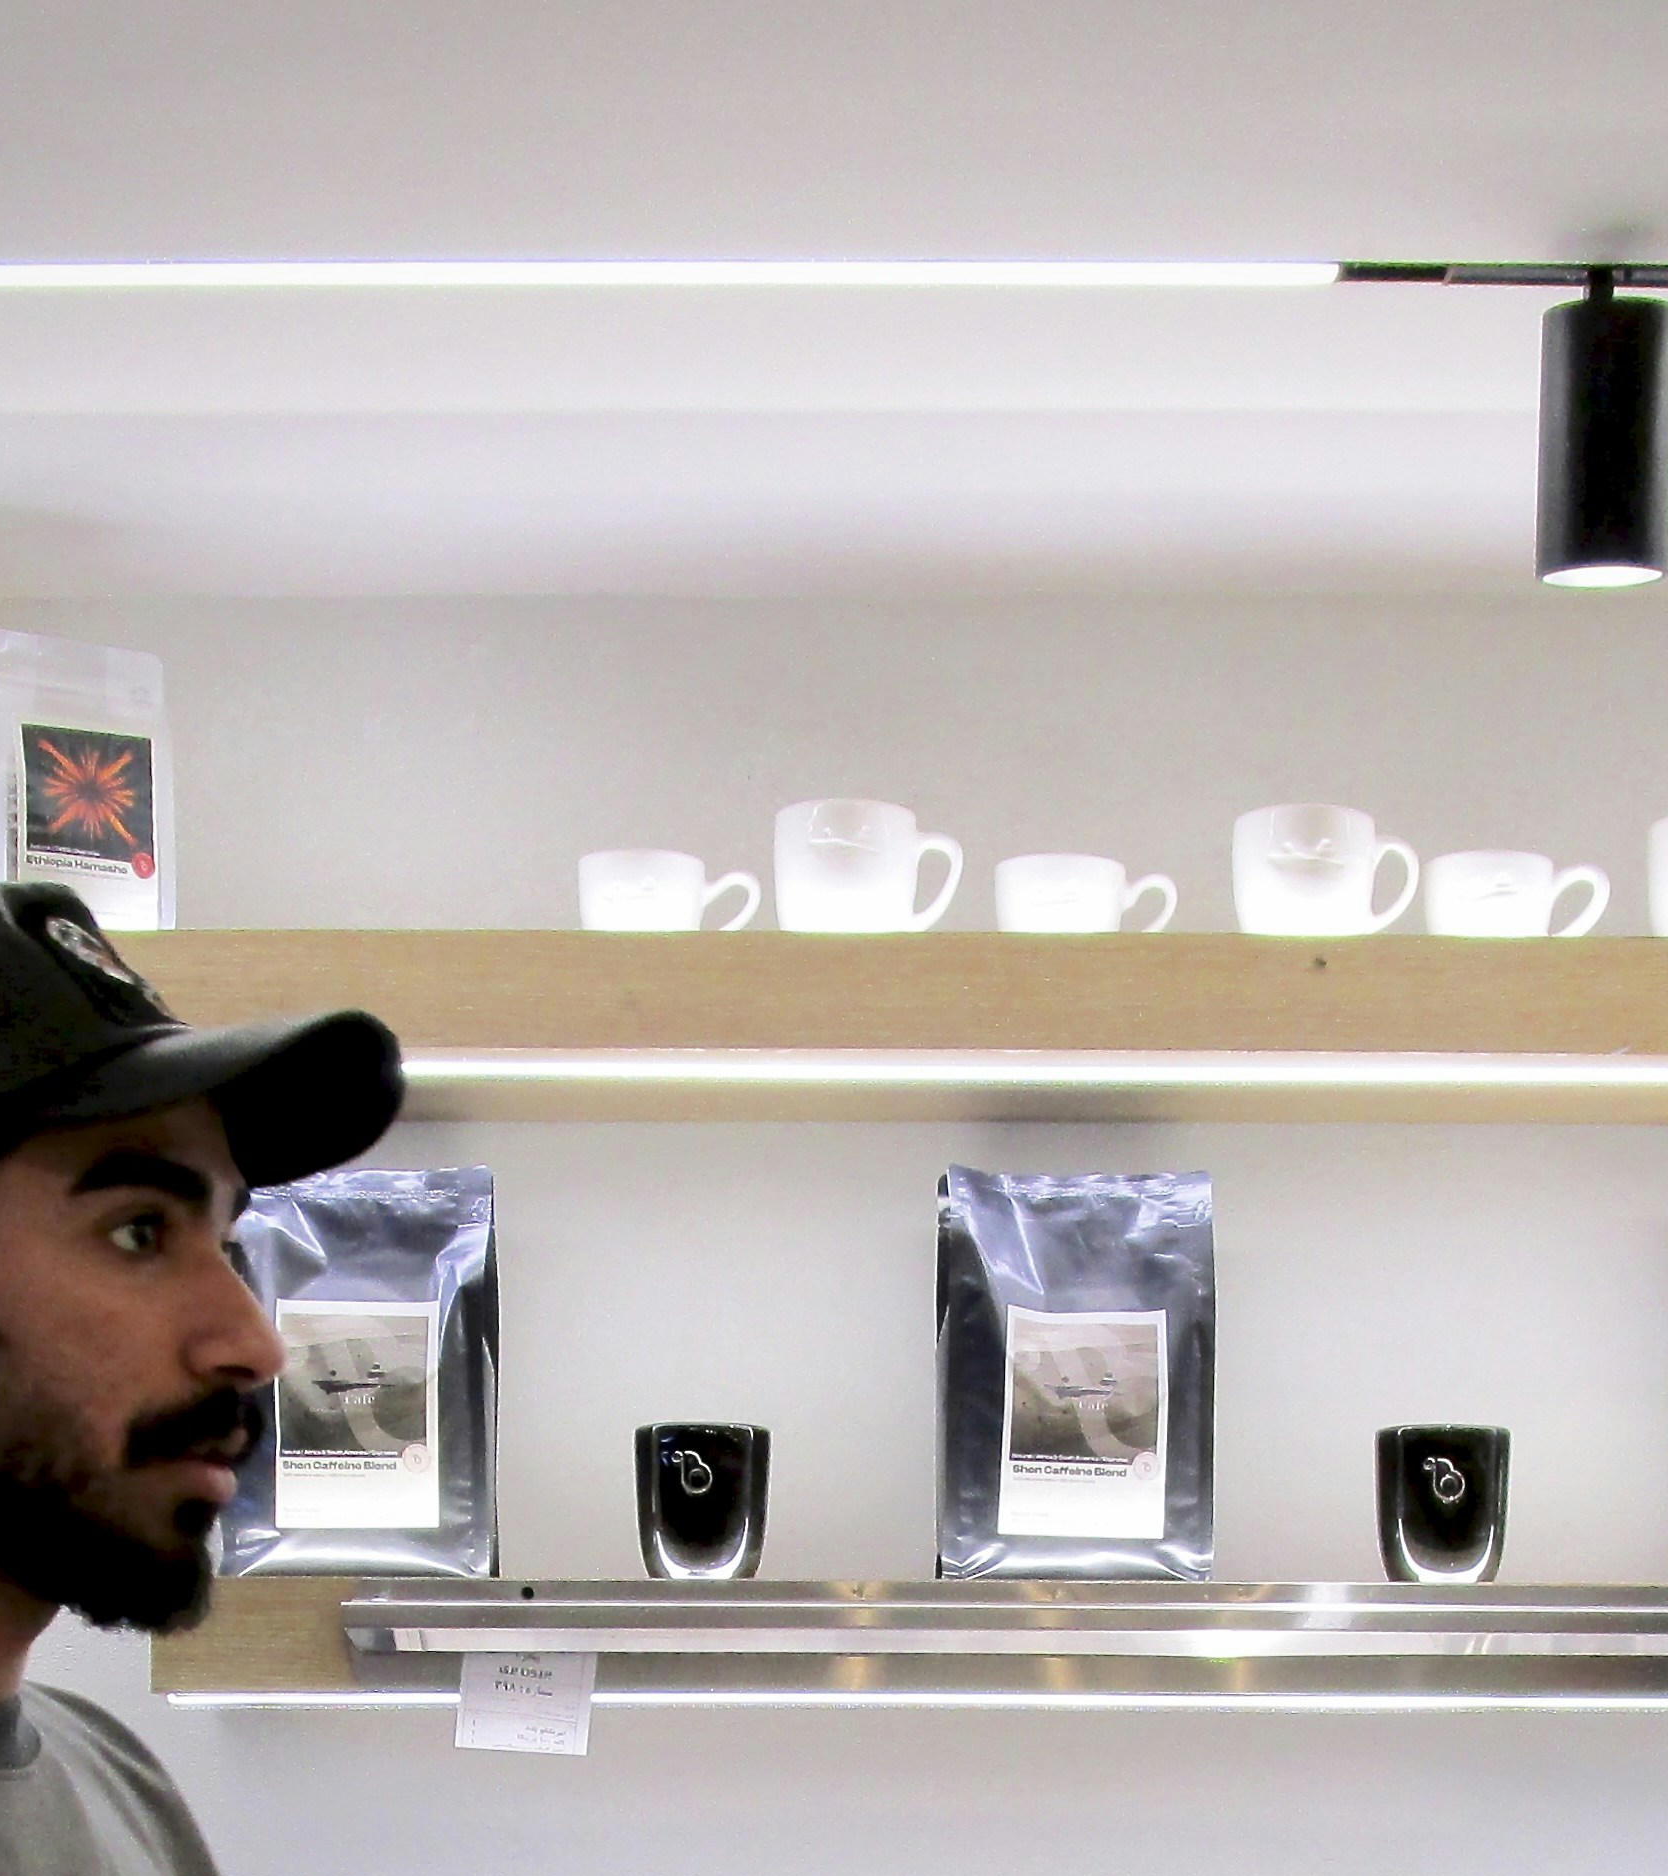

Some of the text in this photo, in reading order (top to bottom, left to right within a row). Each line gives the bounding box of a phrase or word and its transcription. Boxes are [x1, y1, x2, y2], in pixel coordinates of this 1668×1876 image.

[26, 854, 128, 875] Ethiopia Hamasho
[313, 1460, 362, 1470] Caffeine
[363, 1461, 397, 1470] Blend
[1044, 1465, 1093, 1476] Caffeine
[1094, 1467, 1127, 1478] Blend
